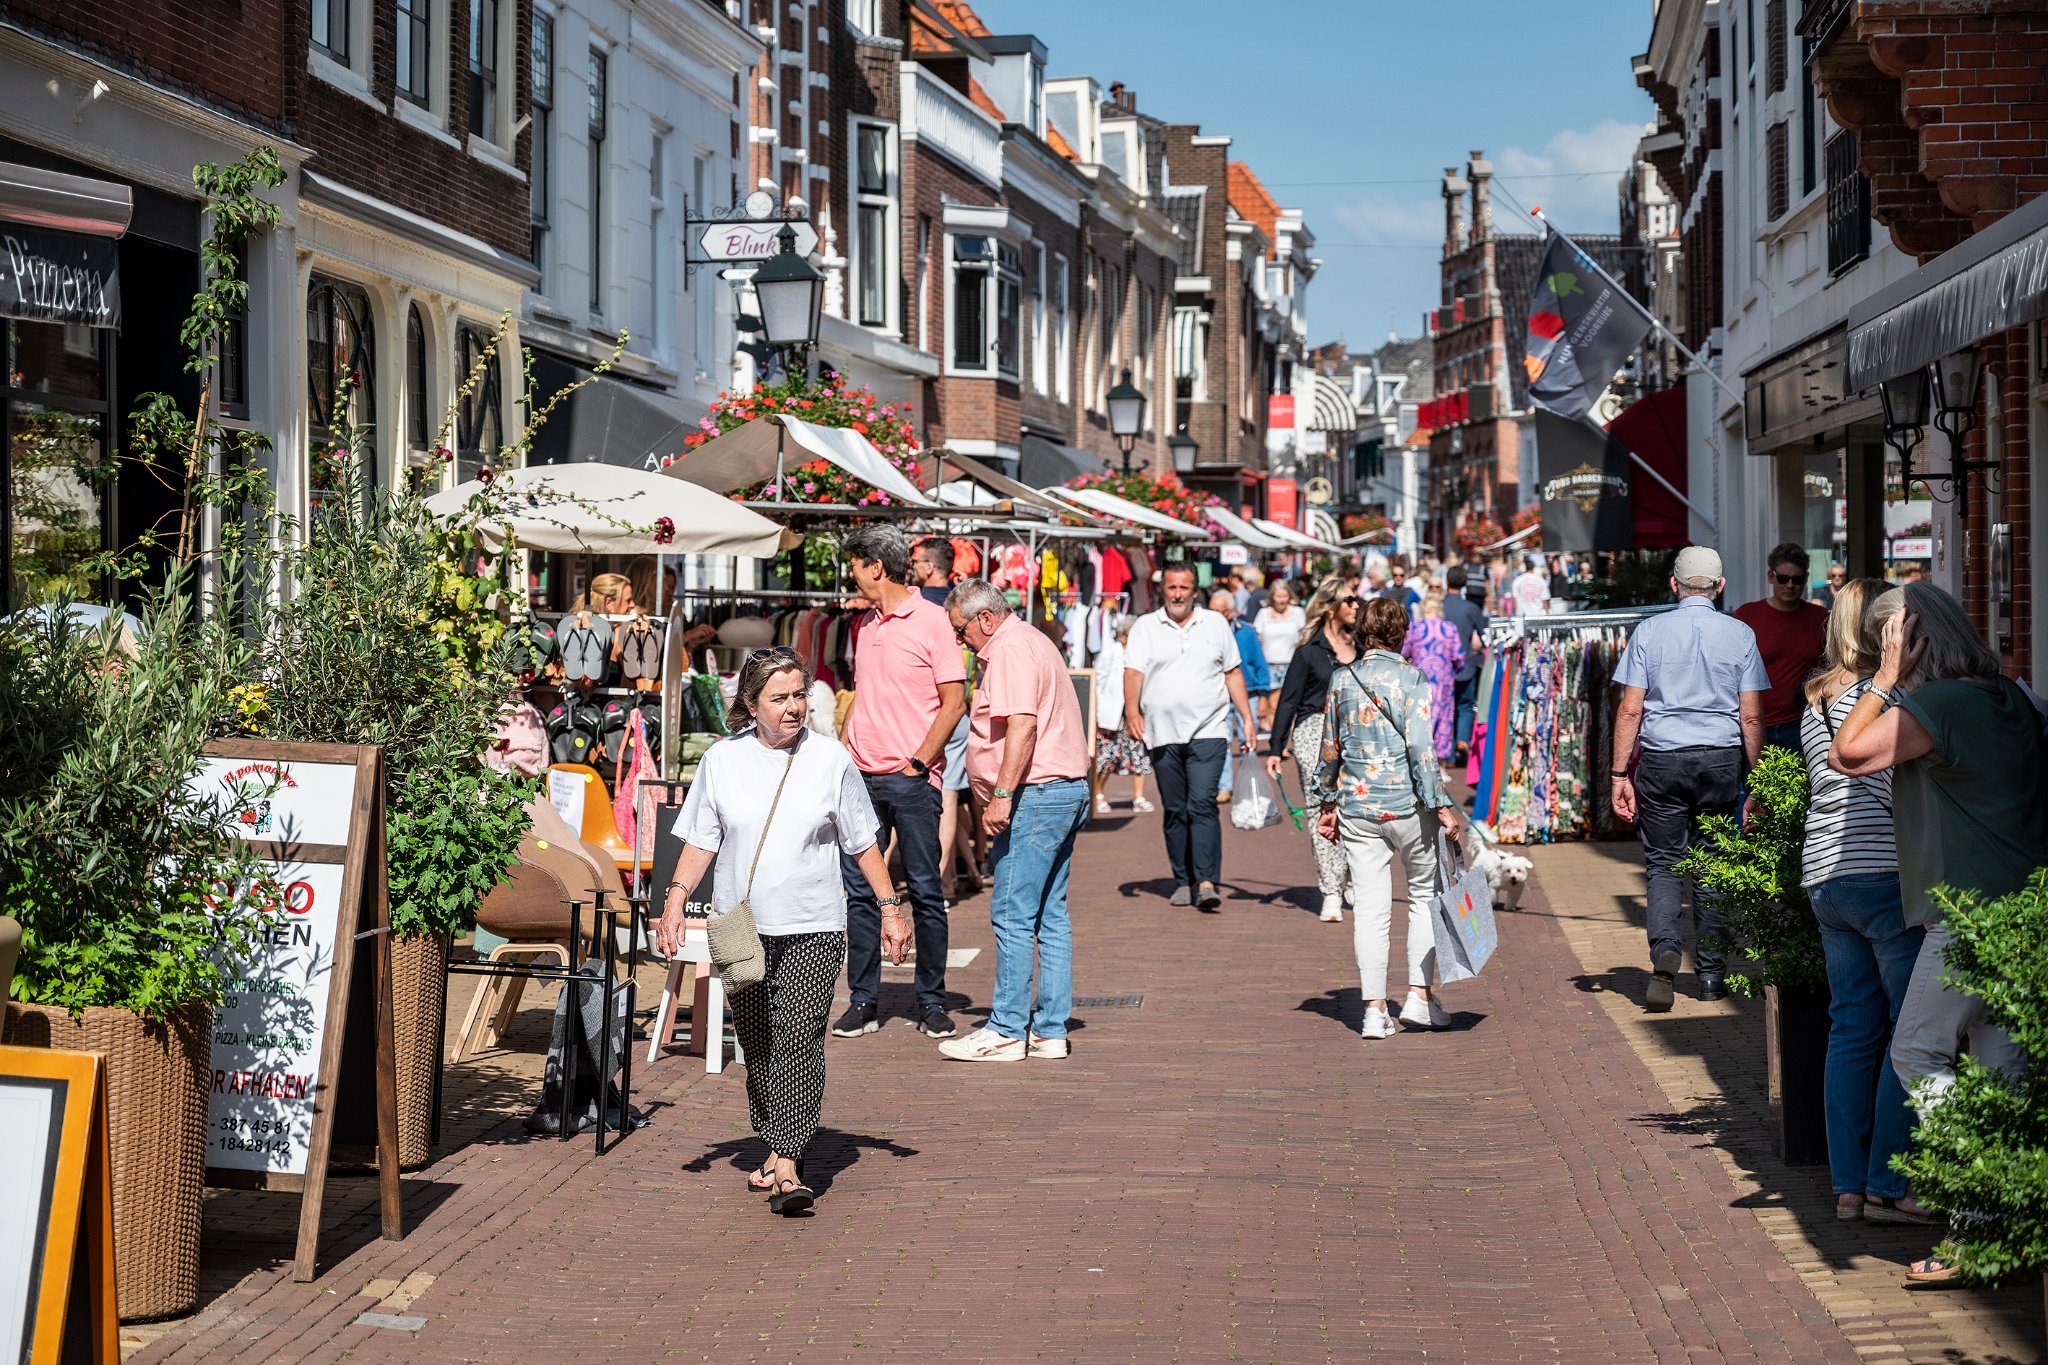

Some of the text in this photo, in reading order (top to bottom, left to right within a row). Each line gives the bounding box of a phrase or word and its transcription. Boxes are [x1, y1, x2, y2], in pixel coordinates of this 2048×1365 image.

[726, 234, 778, 257] Blink
[3, 235, 110, 316] Pizzeria
[1580, 305, 1614, 348] VOORBURG
[248, 980, 296, 995] CHOCOMEL
[214, 1032, 239, 1046] PIZZA
[245, 1034, 277, 1048] KLEINE
[228, 1071, 307, 1100] AFHALEN
[219, 1117, 248, 1132] 387
[251, 1119, 270, 1133] 45
[274, 1121, 291, 1135] 81
[219, 1136, 291, 1155] 18428142
